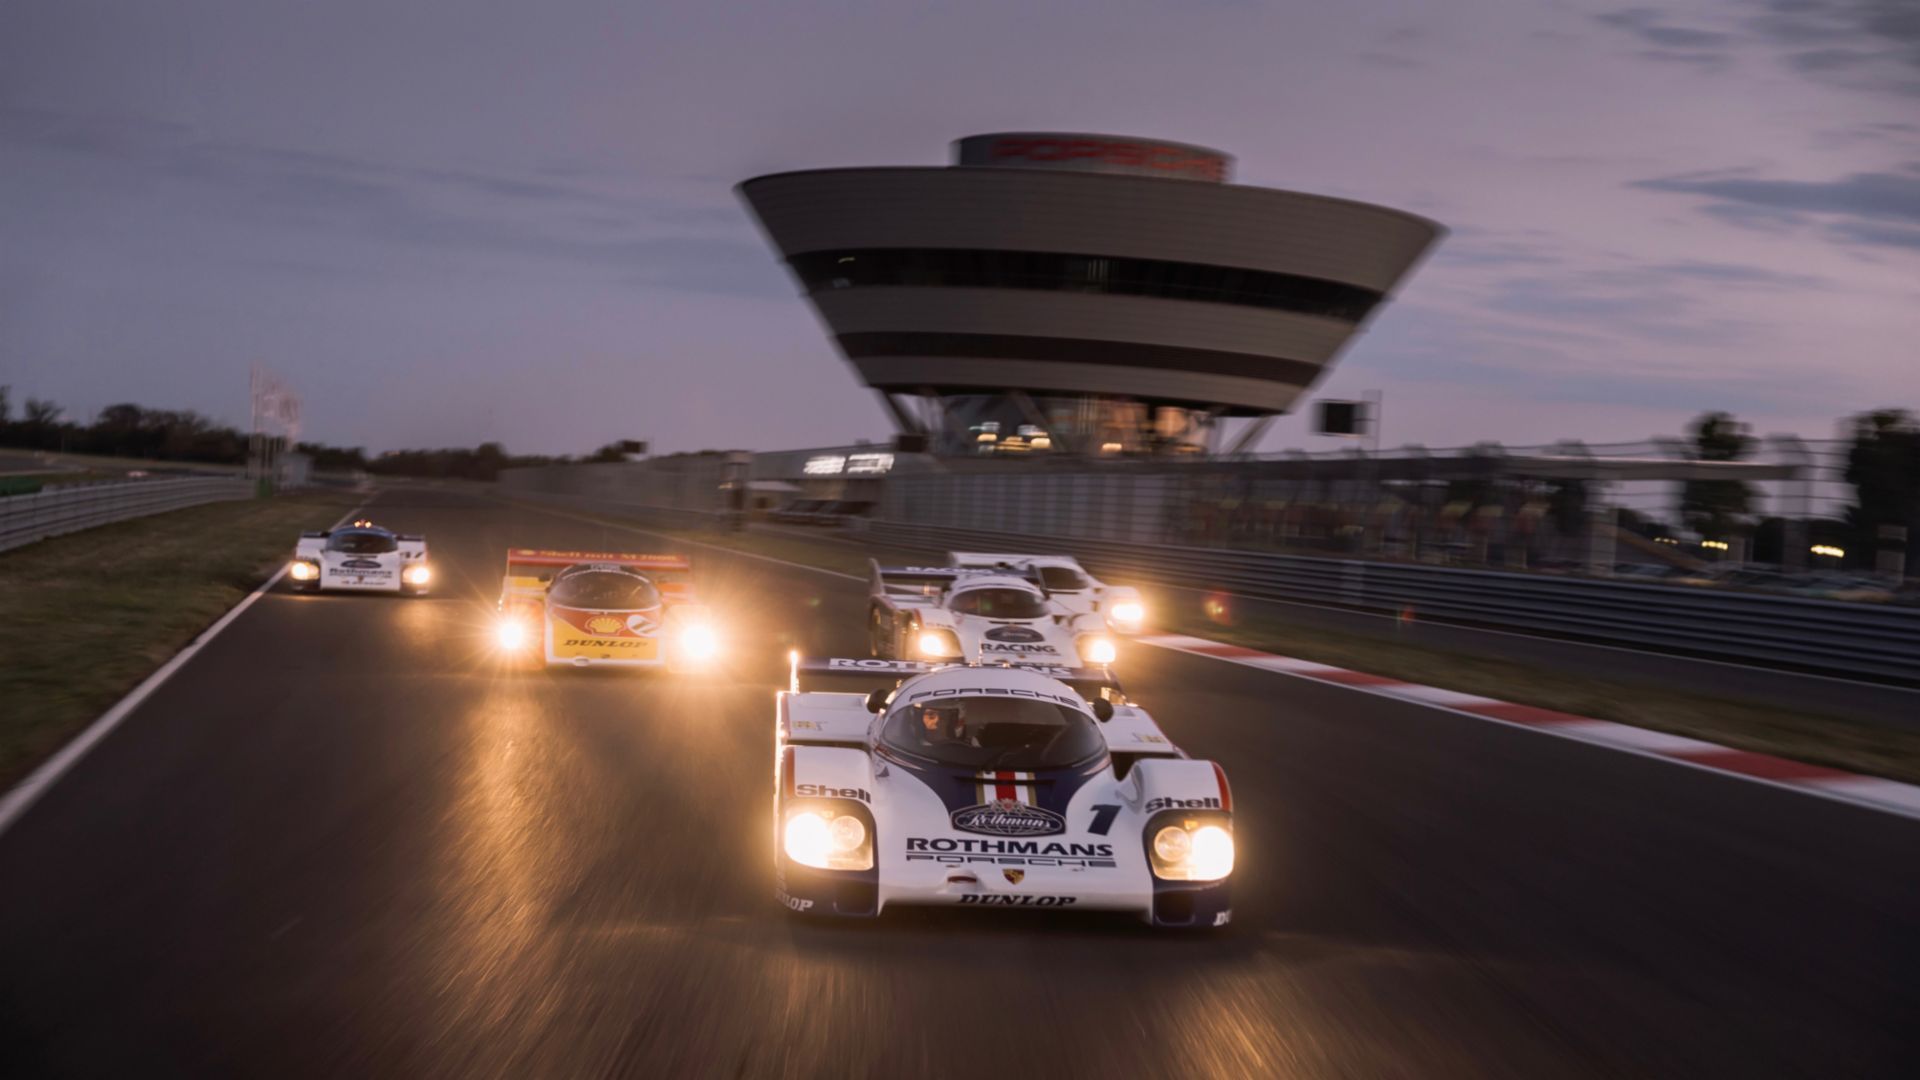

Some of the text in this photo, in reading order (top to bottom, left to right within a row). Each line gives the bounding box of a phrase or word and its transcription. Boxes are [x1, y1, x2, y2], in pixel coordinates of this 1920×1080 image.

[563, 638, 648, 649] DUNLOP
[981, 643, 1056, 653] RACING
[909, 687, 1080, 708] PORSCHE
[796, 783, 872, 804] Shell
[1145, 796, 1221, 814] Shell
[964, 812, 1051, 828] Rothmans
[1087, 803, 1122, 836] 1
[906, 837, 1114, 857] ROTHMANS
[906, 854, 1117, 868] PORSCHE
[958, 893, 1077, 907] DUNLOP
